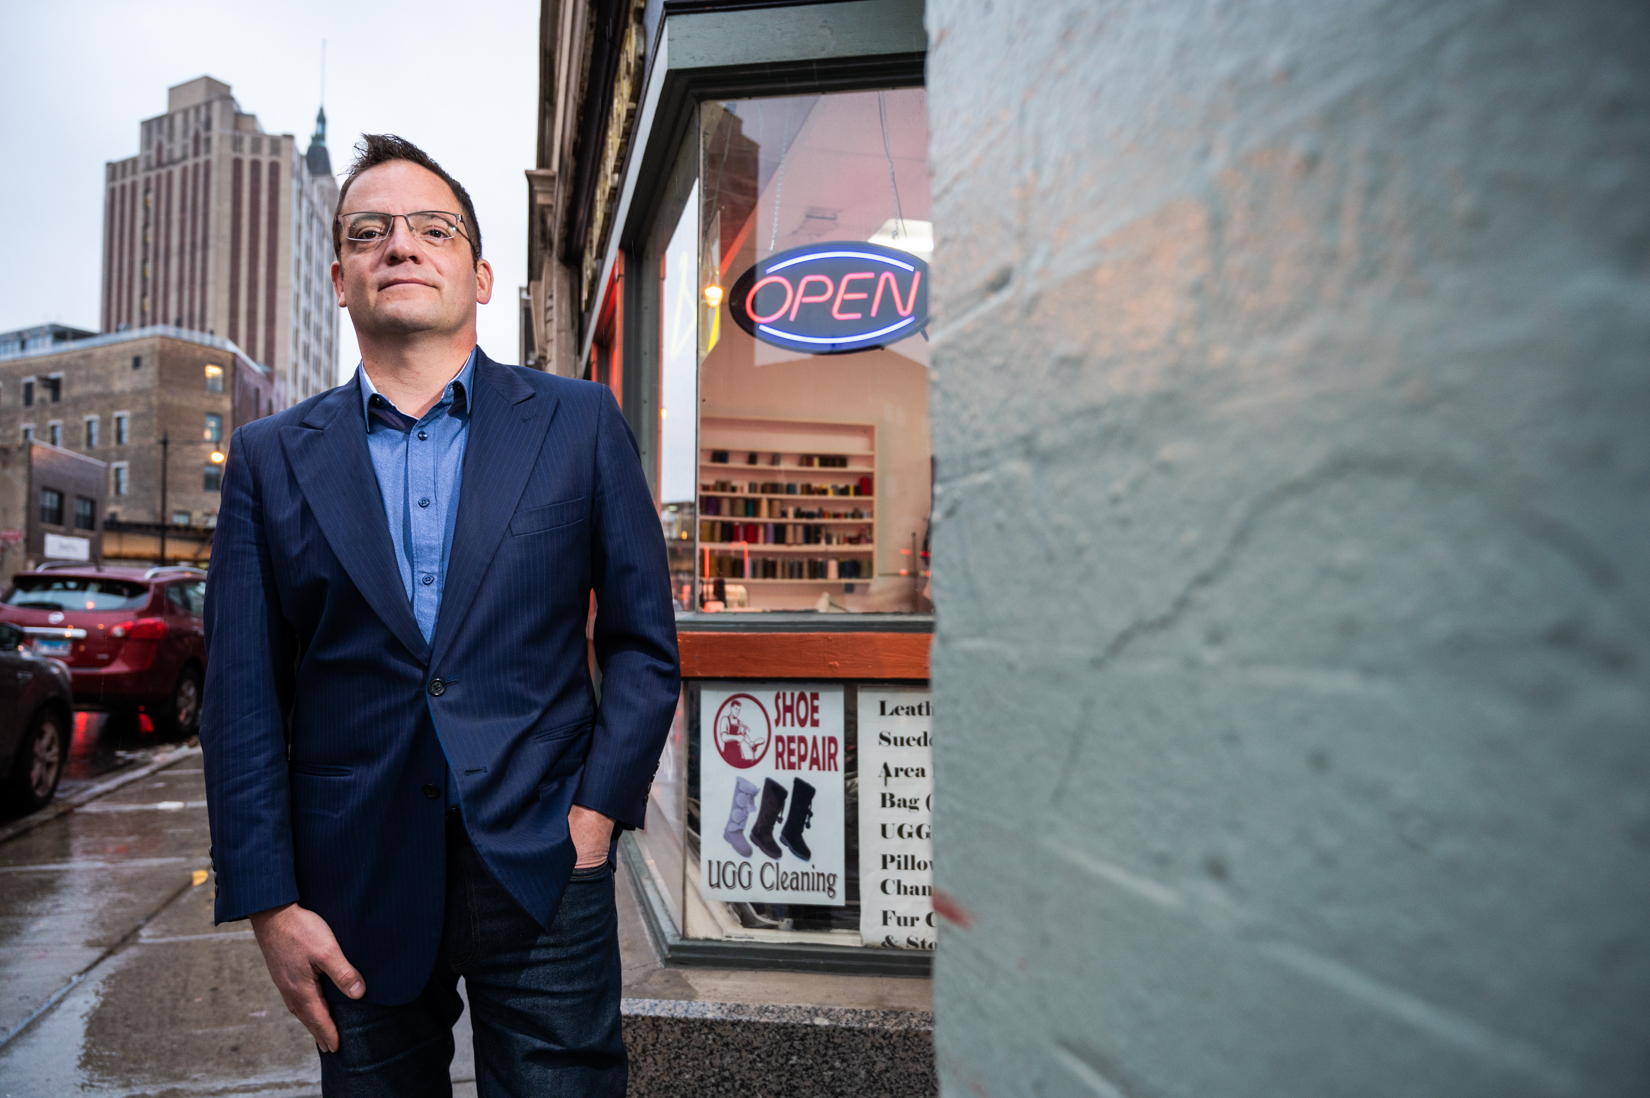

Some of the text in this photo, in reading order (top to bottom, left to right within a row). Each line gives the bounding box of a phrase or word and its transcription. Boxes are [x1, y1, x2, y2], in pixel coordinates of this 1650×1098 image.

[745, 270, 921, 324] OPEN
[774, 690, 820, 728] SHOE
[774, 734, 839, 772] REPAIR
[878, 761, 926, 778] Area
[879, 792, 920, 813] Bag
[880, 823, 931, 840] UGG
[708, 859, 838, 899] UGG Cleaning
[881, 909, 920, 927] Fur
